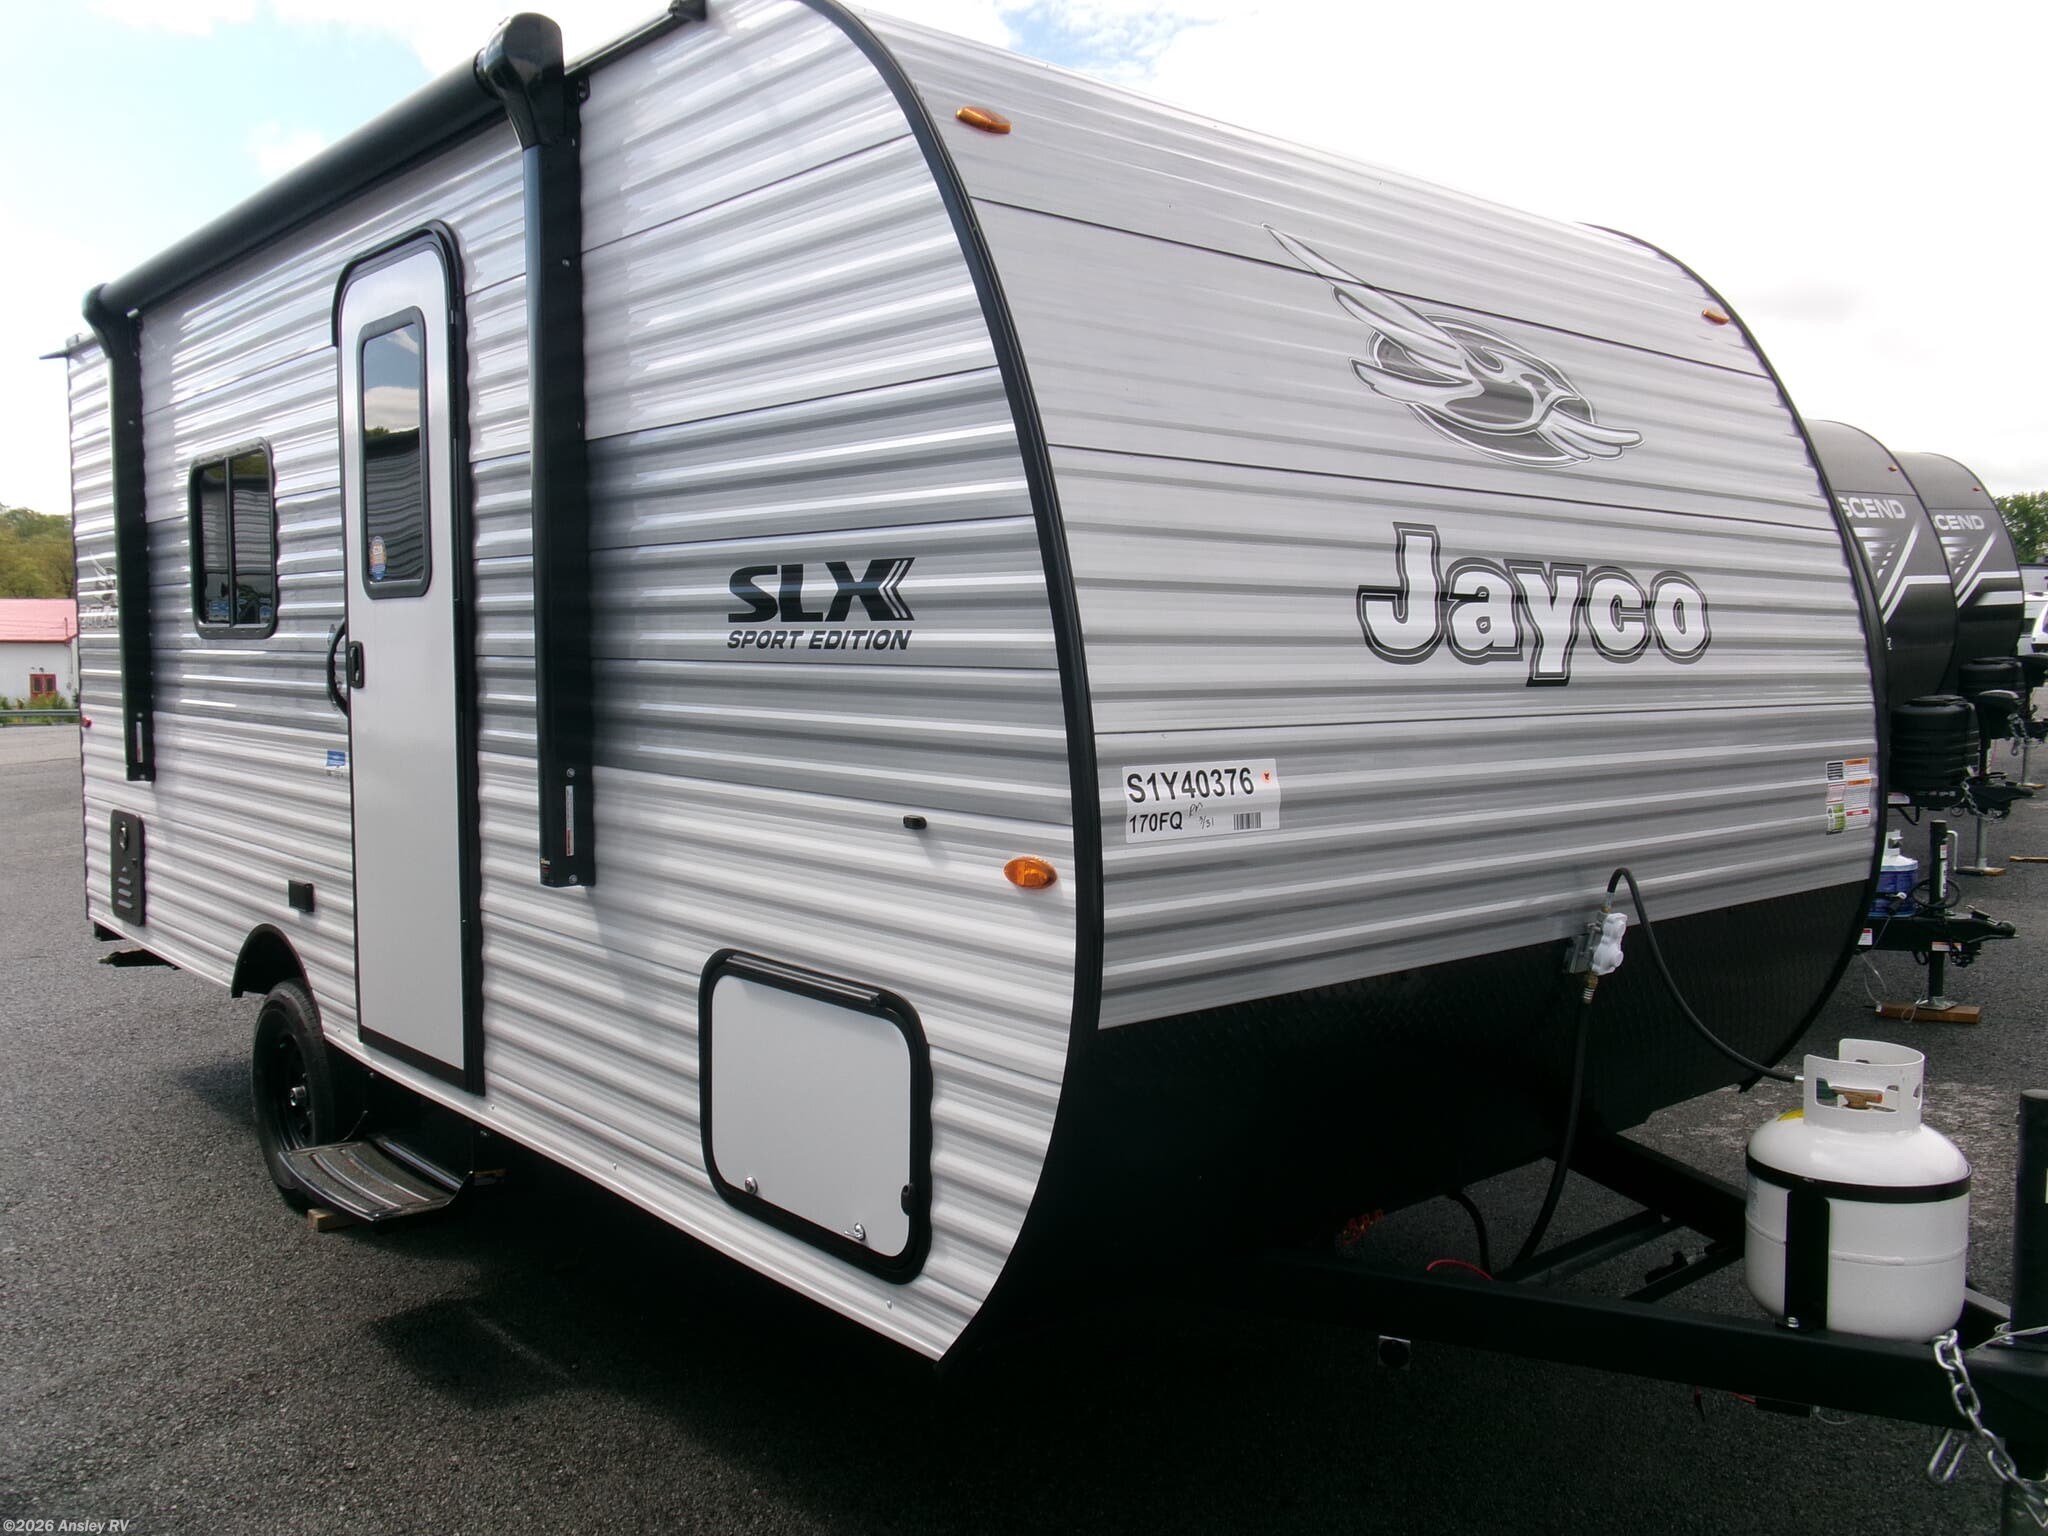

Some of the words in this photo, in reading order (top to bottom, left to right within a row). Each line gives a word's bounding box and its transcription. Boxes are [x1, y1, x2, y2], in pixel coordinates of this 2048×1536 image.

[727, 557, 916, 623] SLX
[1355, 521, 1712, 687] Jayco
[727, 629, 805, 650] SPORT
[808, 629, 913, 651] EDITION
[1126, 767, 1255, 804] S1Y40376
[1129, 811, 1183, 834] 170FQ
